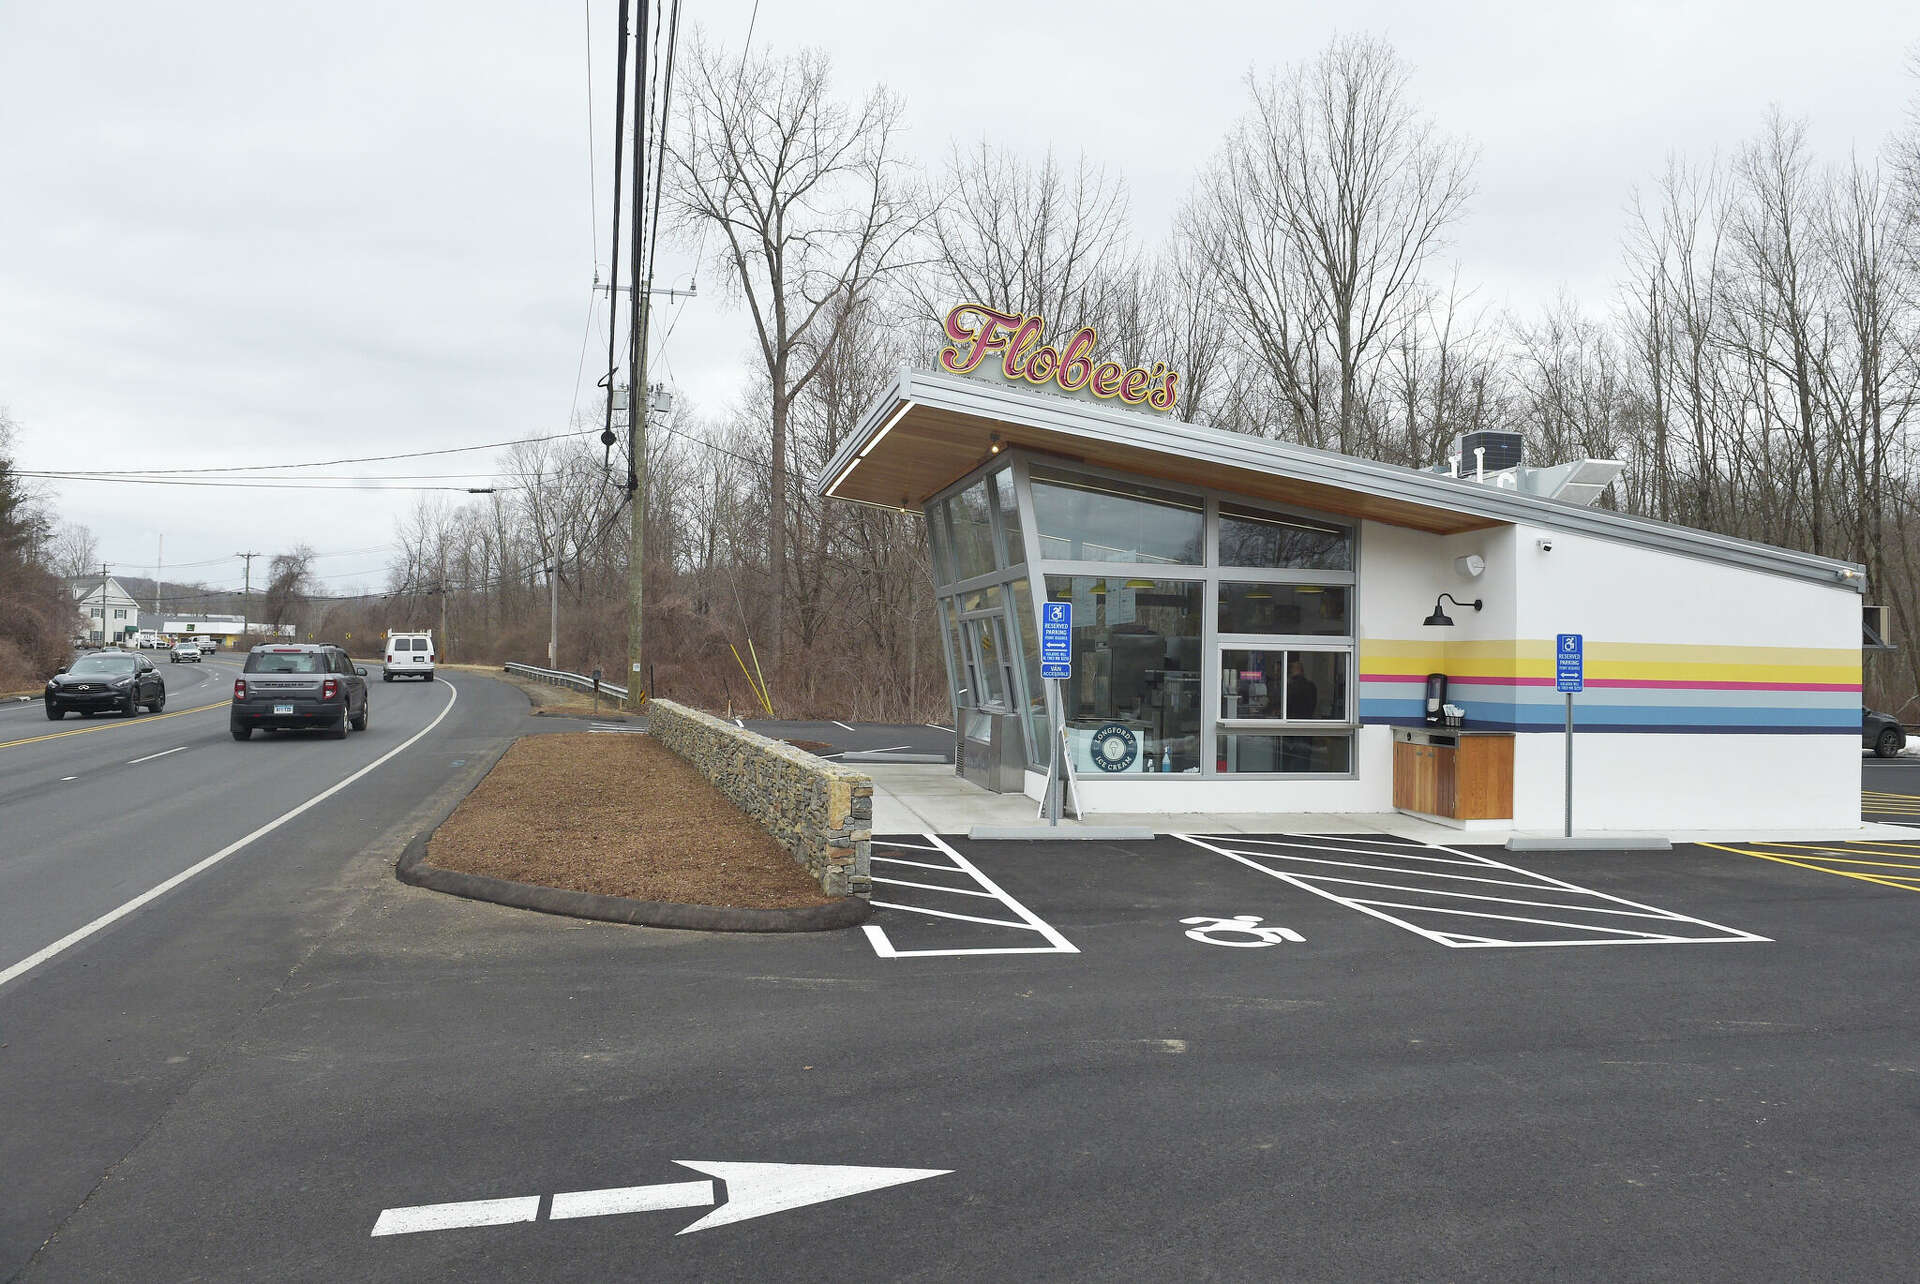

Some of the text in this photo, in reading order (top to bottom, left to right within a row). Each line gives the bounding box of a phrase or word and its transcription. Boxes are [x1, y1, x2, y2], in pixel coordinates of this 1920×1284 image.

[940, 303, 1179, 411] Flobee's
[1095, 756, 1132, 771] ICE CREAM
